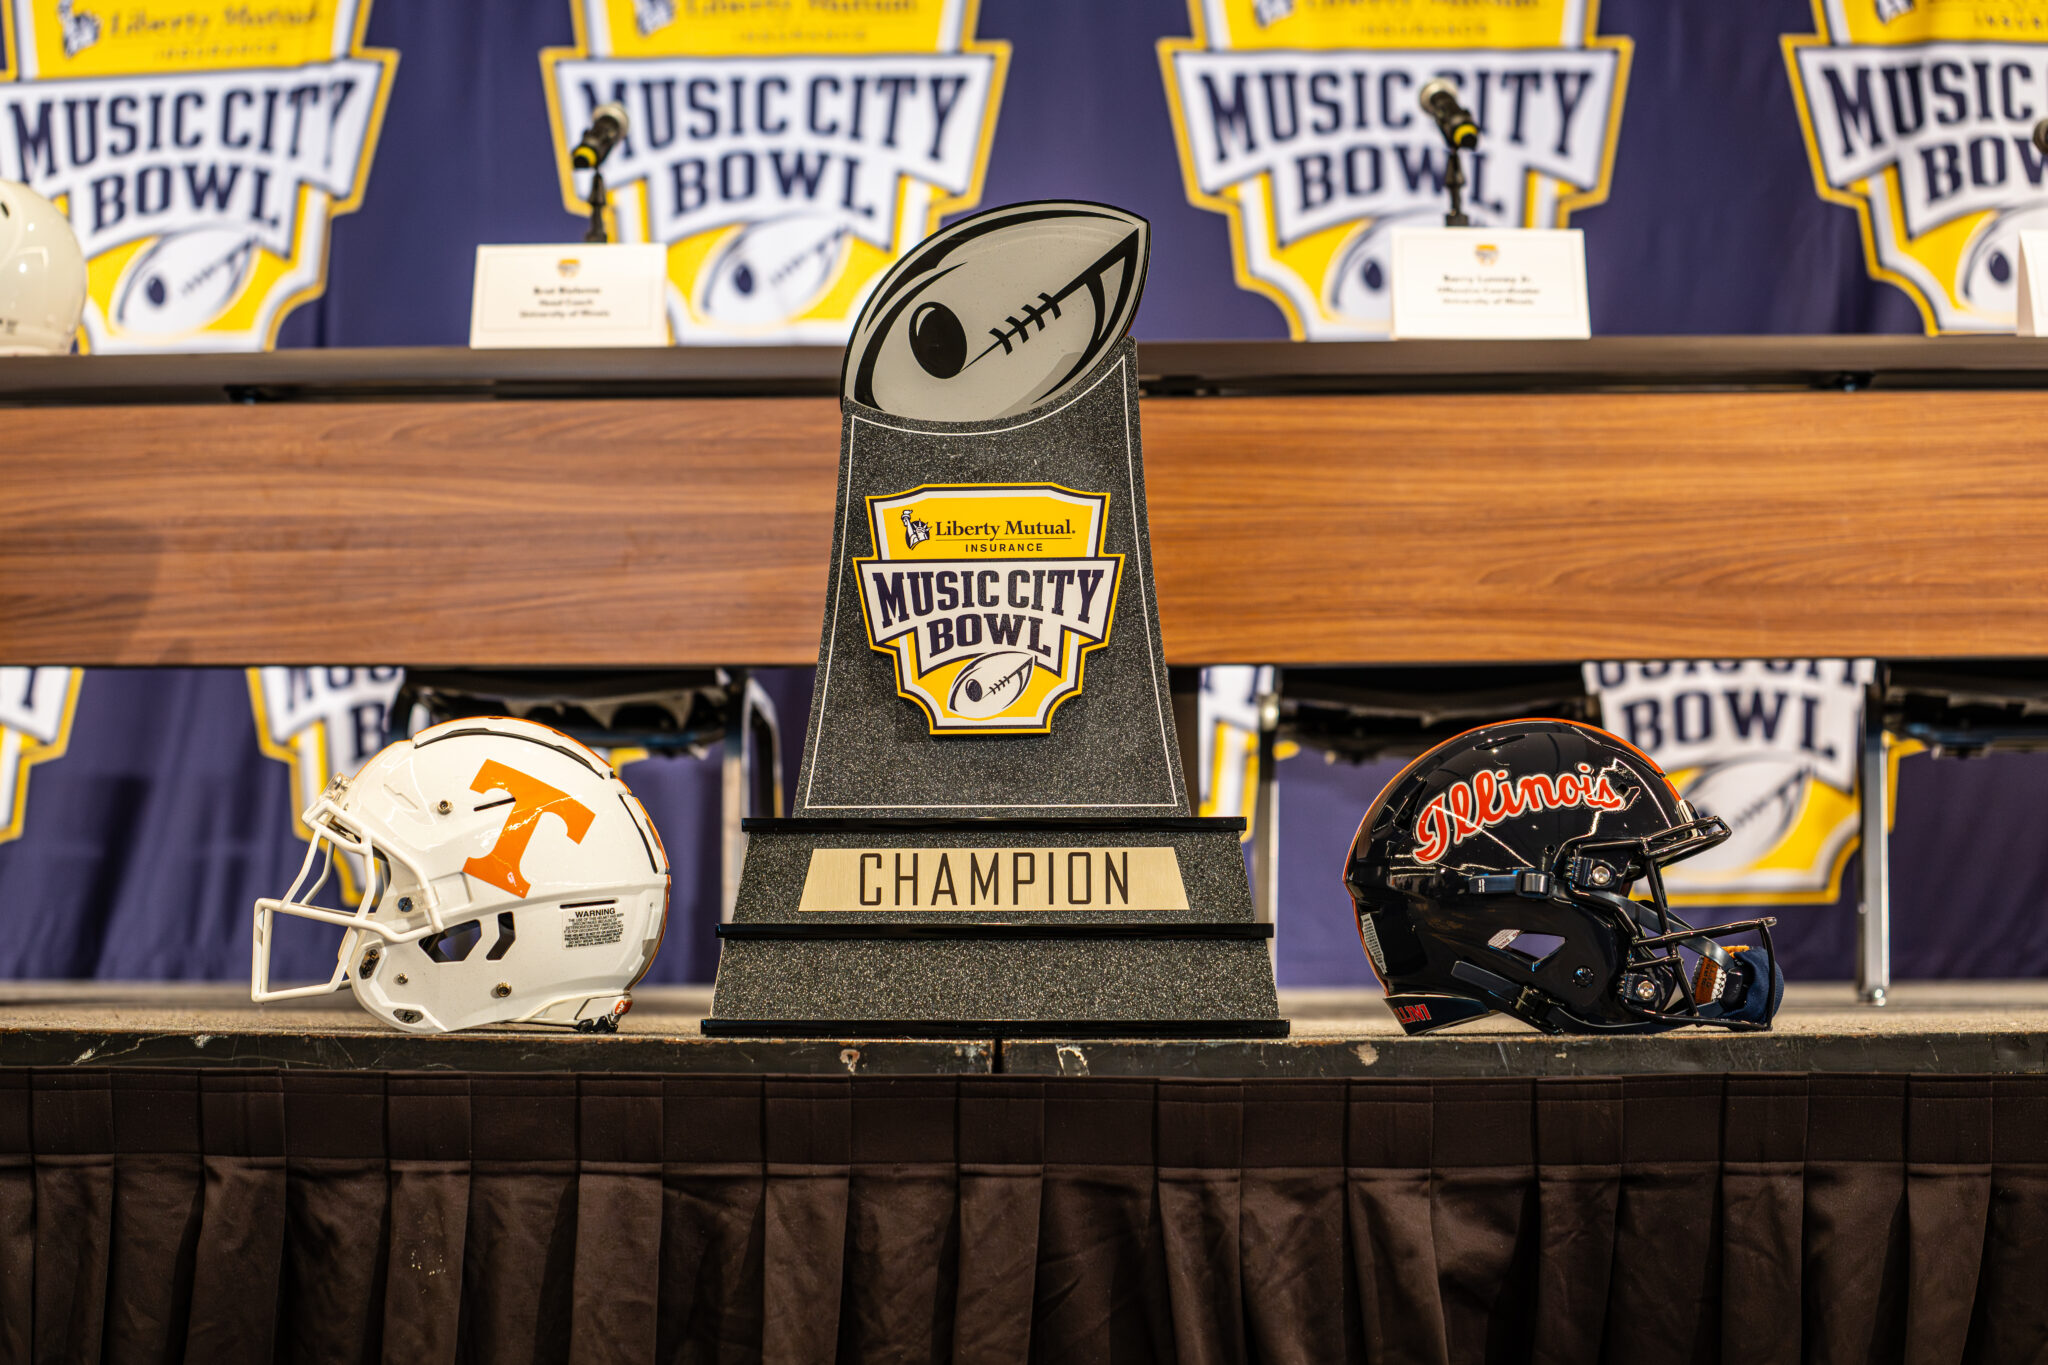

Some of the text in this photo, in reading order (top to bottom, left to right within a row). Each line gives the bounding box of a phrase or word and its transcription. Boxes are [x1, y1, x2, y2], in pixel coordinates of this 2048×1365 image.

[8, 79, 357, 185] MUSIC CITY
[807, 75, 970, 161] CITY
[1199, 69, 1594, 163] MUSIC ITY
[1822, 60, 2034, 158] MUSIC
[90, 163, 280, 235] BOWL
[669, 148, 875, 218] BOWL
[1295, 143, 1505, 214] BOWL
[1918, 135, 2048, 204] BO
[935, 520, 1000, 541] Liberty
[965, 543, 1043, 552] INSURANCE
[872, 569, 1105, 629] MUSIC CITY
[926, 613, 1051, 658] BOWL
[1621, 687, 1836, 760] BOWL
[462, 758, 596, 899] T
[1412, 763, 1625, 864] Illinois
[575, 908, 615, 917] WARNING
[859, 852, 1129, 906] CHAMPION
[1393, 1003, 1432, 1024] LLINI
